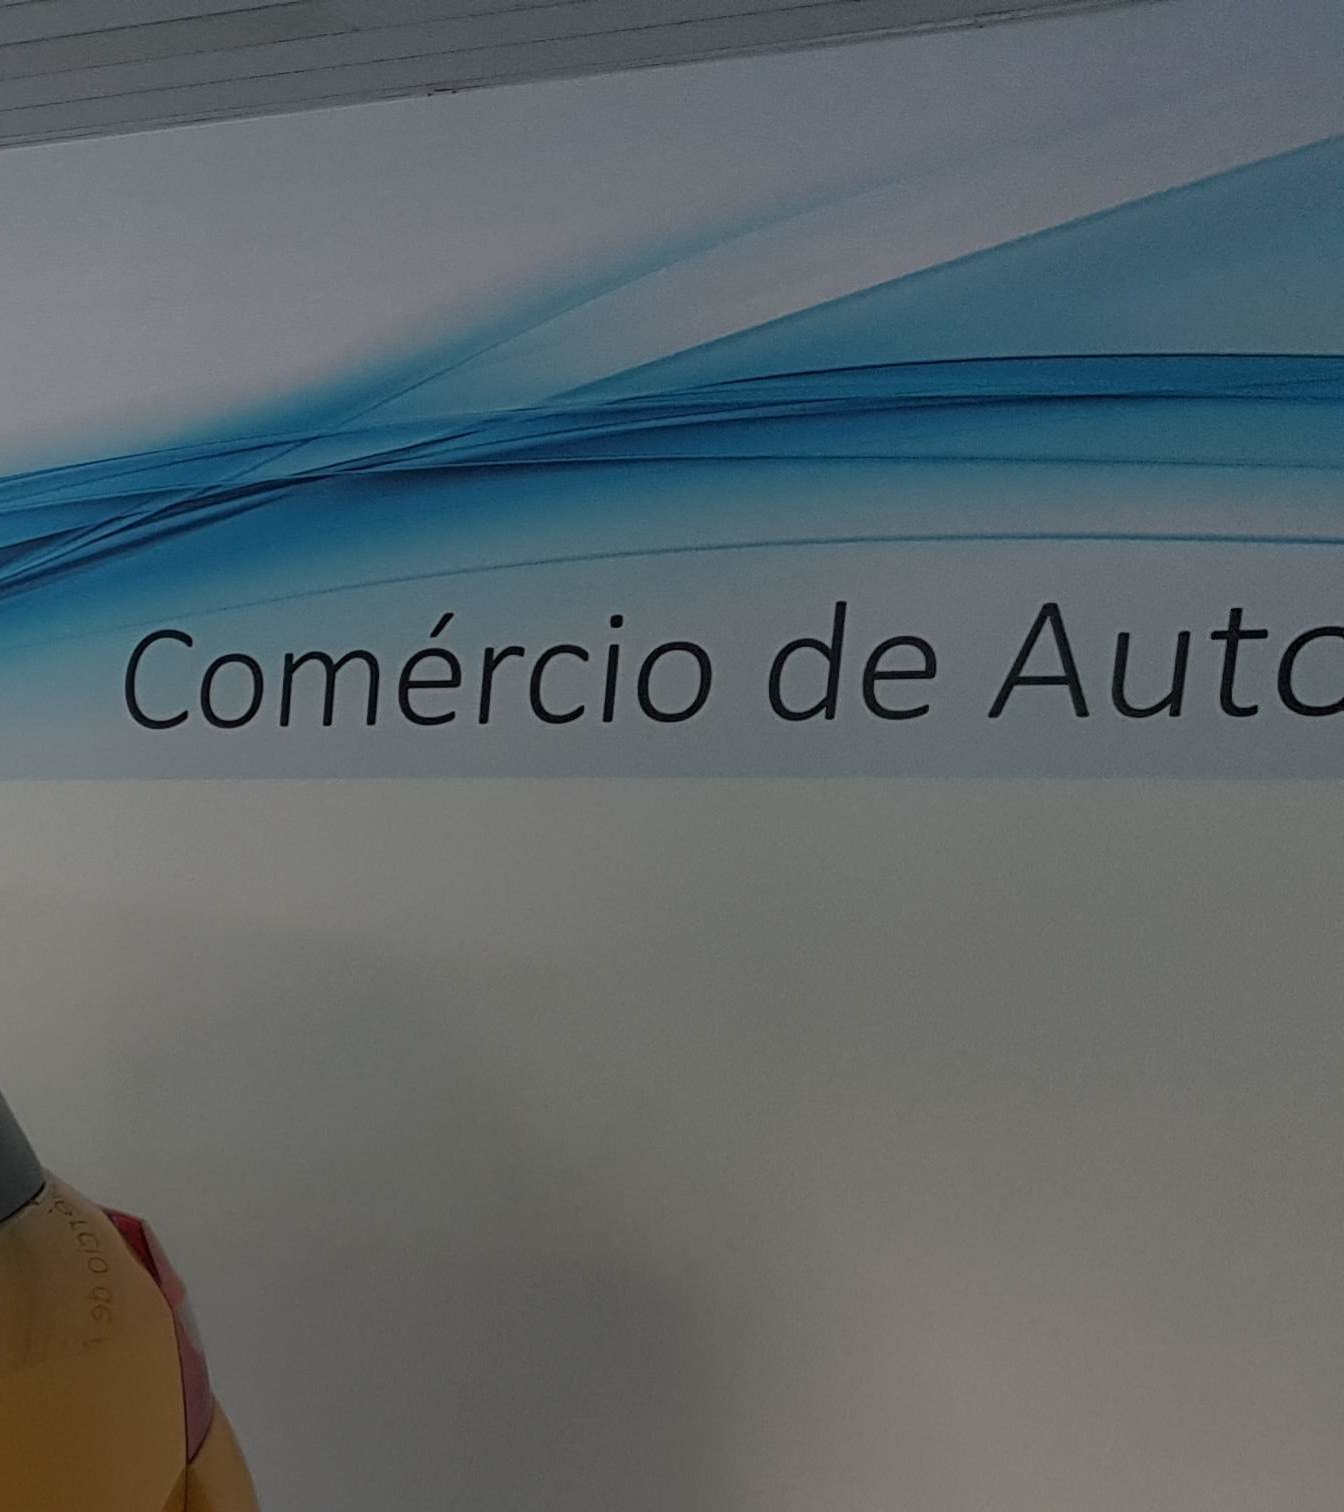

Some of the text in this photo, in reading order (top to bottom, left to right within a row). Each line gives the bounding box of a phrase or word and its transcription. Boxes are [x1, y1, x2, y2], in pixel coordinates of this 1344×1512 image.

[122, 600, 1344, 731] Comércio de Auto
